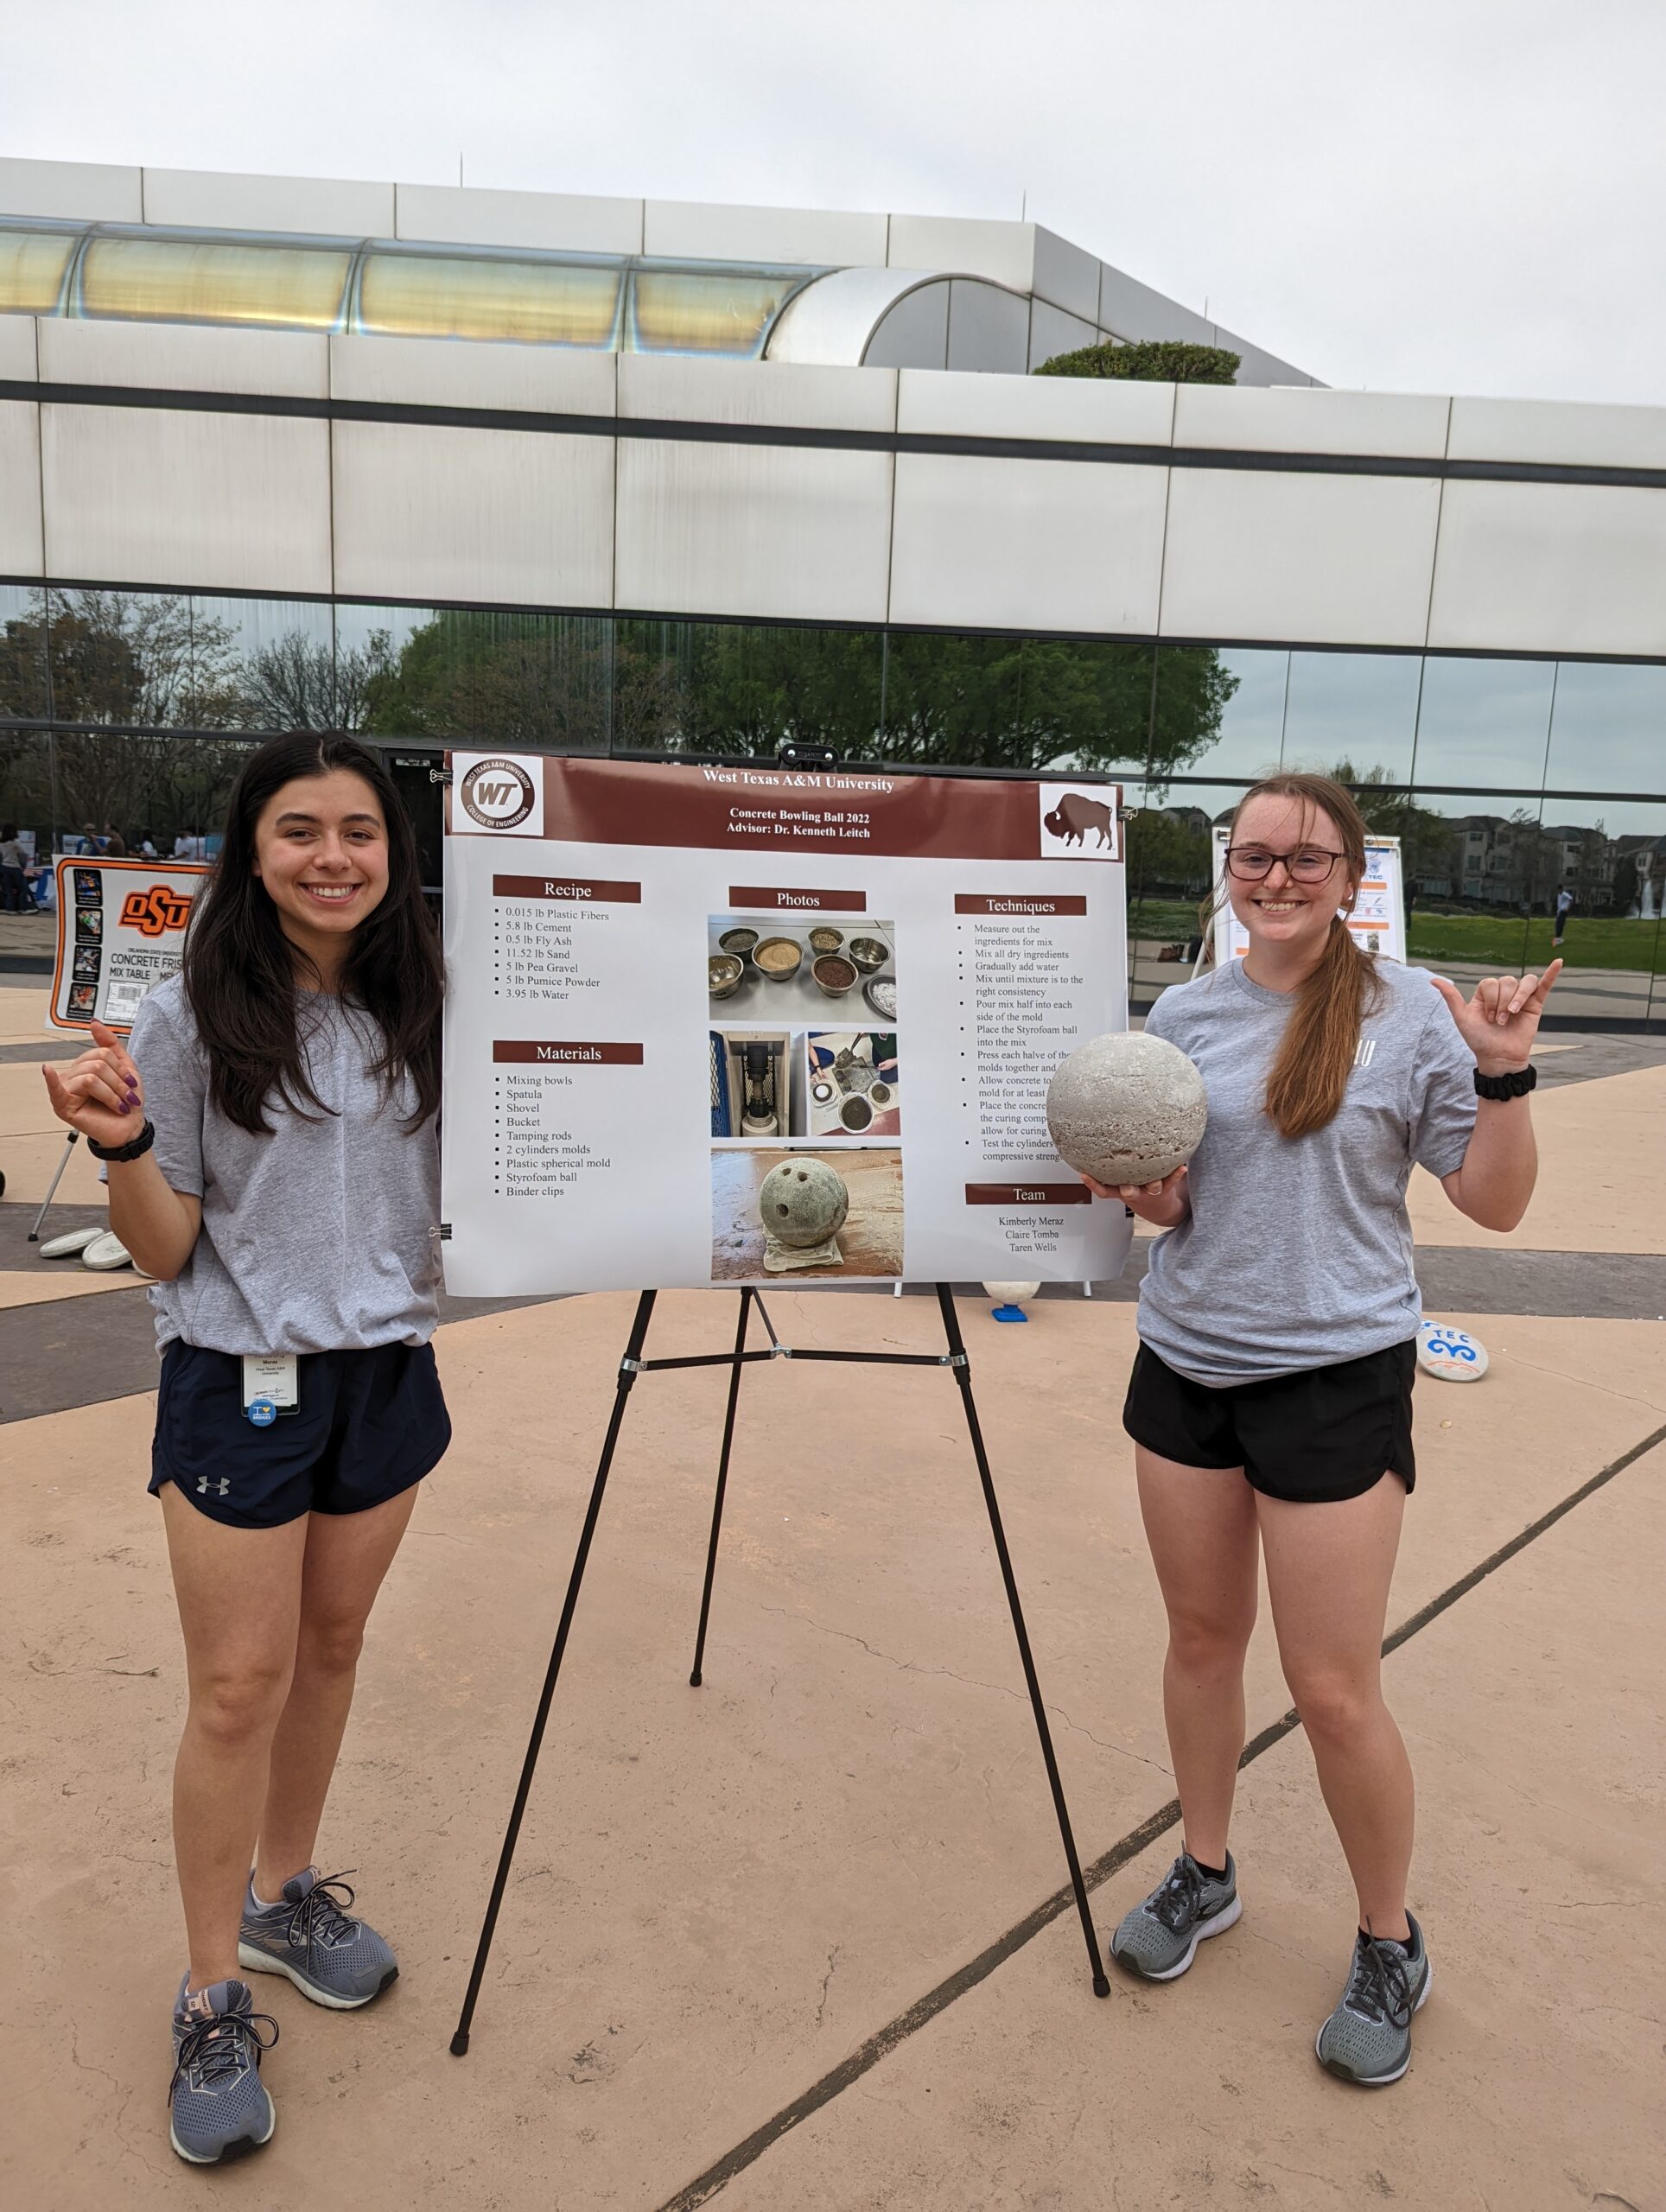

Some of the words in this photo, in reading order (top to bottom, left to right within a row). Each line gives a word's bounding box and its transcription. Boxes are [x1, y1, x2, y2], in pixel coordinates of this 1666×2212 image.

[465, 772, 477, 787] WEST
[475, 763, 491, 775] TEXAS
[506, 763, 531, 789] UNIVERSITY
[703, 769, 737, 784] West
[741, 772, 779, 786] Texas
[783, 774, 822, 788] A&M
[826, 777, 894, 793] University
[479, 783, 518, 806] WT
[467, 804, 487, 824] COLLEGE
[496, 806, 529, 828] ENGINEERING
[729, 808, 777, 819] Concrete
[779, 810, 822, 823] Bowling
[823, 812, 844, 823] Ball
[847, 813, 870, 823] 2022
[727, 823, 772, 834] Advisor:
[774, 825, 790, 835] Dr.
[793, 825, 836, 836] Kenneth
[839, 828, 870, 838] Leitch
[544, 882, 592, 899] Recipe
[777, 893, 820, 906] Photos
[118, 885, 195, 938] OSU
[986, 899, 1056, 915] Techniques
[506, 907, 532, 918] 0.015
[535, 909, 544, 918] lb
[547, 910, 578, 919] Plastic
[581, 911, 609, 921] Fibers
[506, 922, 521, 931] 5.8
[524, 922, 533, 931] lb
[536, 923, 572, 932] Cement
[974, 925, 1010, 933] Measure
[1027, 925, 1040, 934] the
[506, 935, 520, 944] 0.5
[524, 936, 533, 944] lb
[536, 936, 551, 947] Fly
[553, 937, 572, 946] Ash
[975, 938, 1021, 947] ingredients
[1023, 938, 1035, 946] for
[506, 949, 532, 958] 11.52
[535, 950, 544, 959] lb
[547, 950, 570, 959] Sand
[975, 950, 992, 958] Mix
[995, 950, 1006, 958] all
[1008, 950, 1021, 960] dry
[1024, 950, 1070, 960] ingredients
[111, 953, 160, 968] CONCRETE
[162, 958, 183, 969] FRIS
[506, 963, 512, 971] 5
[515, 963, 525, 971] lb
[527, 963, 544, 972] Pea
[547, 963, 578, 973] Gravel
[976, 962, 1016, 972] Gradually
[1019, 963, 1034, 971] add
[110, 967, 124, 977] MIX
[126, 969, 151, 980] TABLE
[506, 976, 512, 985] 5
[515, 976, 525, 985] lb
[527, 976, 563, 986] Pumice
[565, 977, 601, 987] Powder
[976, 975, 993, 983] Mix
[995, 975, 1014, 983] until
[1017, 976, 1049, 984] mixture
[1052, 976, 1059, 984] is
[1071, 976, 1084, 984] the
[506, 989, 526, 999] 3.95
[530, 990, 539, 999] lb
[542, 990, 569, 1000] Water
[976, 988, 995, 998] right
[998, 988, 1046, 998] consistency
[1035, 1001, 1052, 1009] into
[1053, 1001, 1073, 1009] each
[976, 1013, 994, 1021] side
[995, 1013, 1007, 1021] of
[1007, 1013, 1020, 1021] the
[1022, 1013, 1043, 1021] mold
[977, 1026, 1000, 1034] Place
[1002, 1026, 1014, 1034] the
[1017, 1026, 1060, 1036] Styrofoam
[1063, 1026, 1078, 1034] ball
[537, 1046, 602, 1060] Materials
[1002, 1051, 1021, 1059] each
[1023, 1051, 1046, 1059] halve
[1047, 1051, 1059, 1059] of
[1006, 1064, 1039, 1074] together
[1041, 1064, 1057, 1072] and
[506, 1076, 542, 1087] Mixing
[544, 1076, 573, 1085] bowls
[506, 1090, 543, 1101] Spatula
[979, 1089, 1000, 1097] mold
[1002, 1089, 1014, 1097] for
[1027, 1089, 1046, 1097] least
[506, 1103, 540, 1113] Shovel
[506, 1117, 541, 1127] Bucket
[995, 1115, 1021, 1124] curing
[1024, 1116, 1046, 1125] comp
[506, 1132, 549, 1142] Tamping
[551, 1132, 572, 1141] rods
[981, 1127, 1003, 1135] allow
[1021, 1127, 1047, 1137] curing
[1016, 1139, 1053, 1149] cylinders
[506, 1146, 512, 1154] 2
[515, 1145, 559, 1156] cylinders
[562, 1145, 591, 1154] molds
[982, 1152, 1033, 1162] compressive
[1036, 1152, 1063, 1162] streng
[506, 1160, 538, 1168] Plastic
[541, 1159, 583, 1170] spherical
[587, 1159, 611, 1168] mold
[506, 1173, 556, 1184] Styrofoam
[560, 1173, 577, 1182] ball
[506, 1187, 539, 1197] Binder
[542, 1187, 564, 1198] clips
[1014, 1188, 1046, 1201] Team
[999, 1217, 1037, 1227] Kimberly
[1006, 1230, 1030, 1239] Claire
[1009, 1243, 1033, 1252] Taren
[1034, 1243, 1057, 1252] Wells
